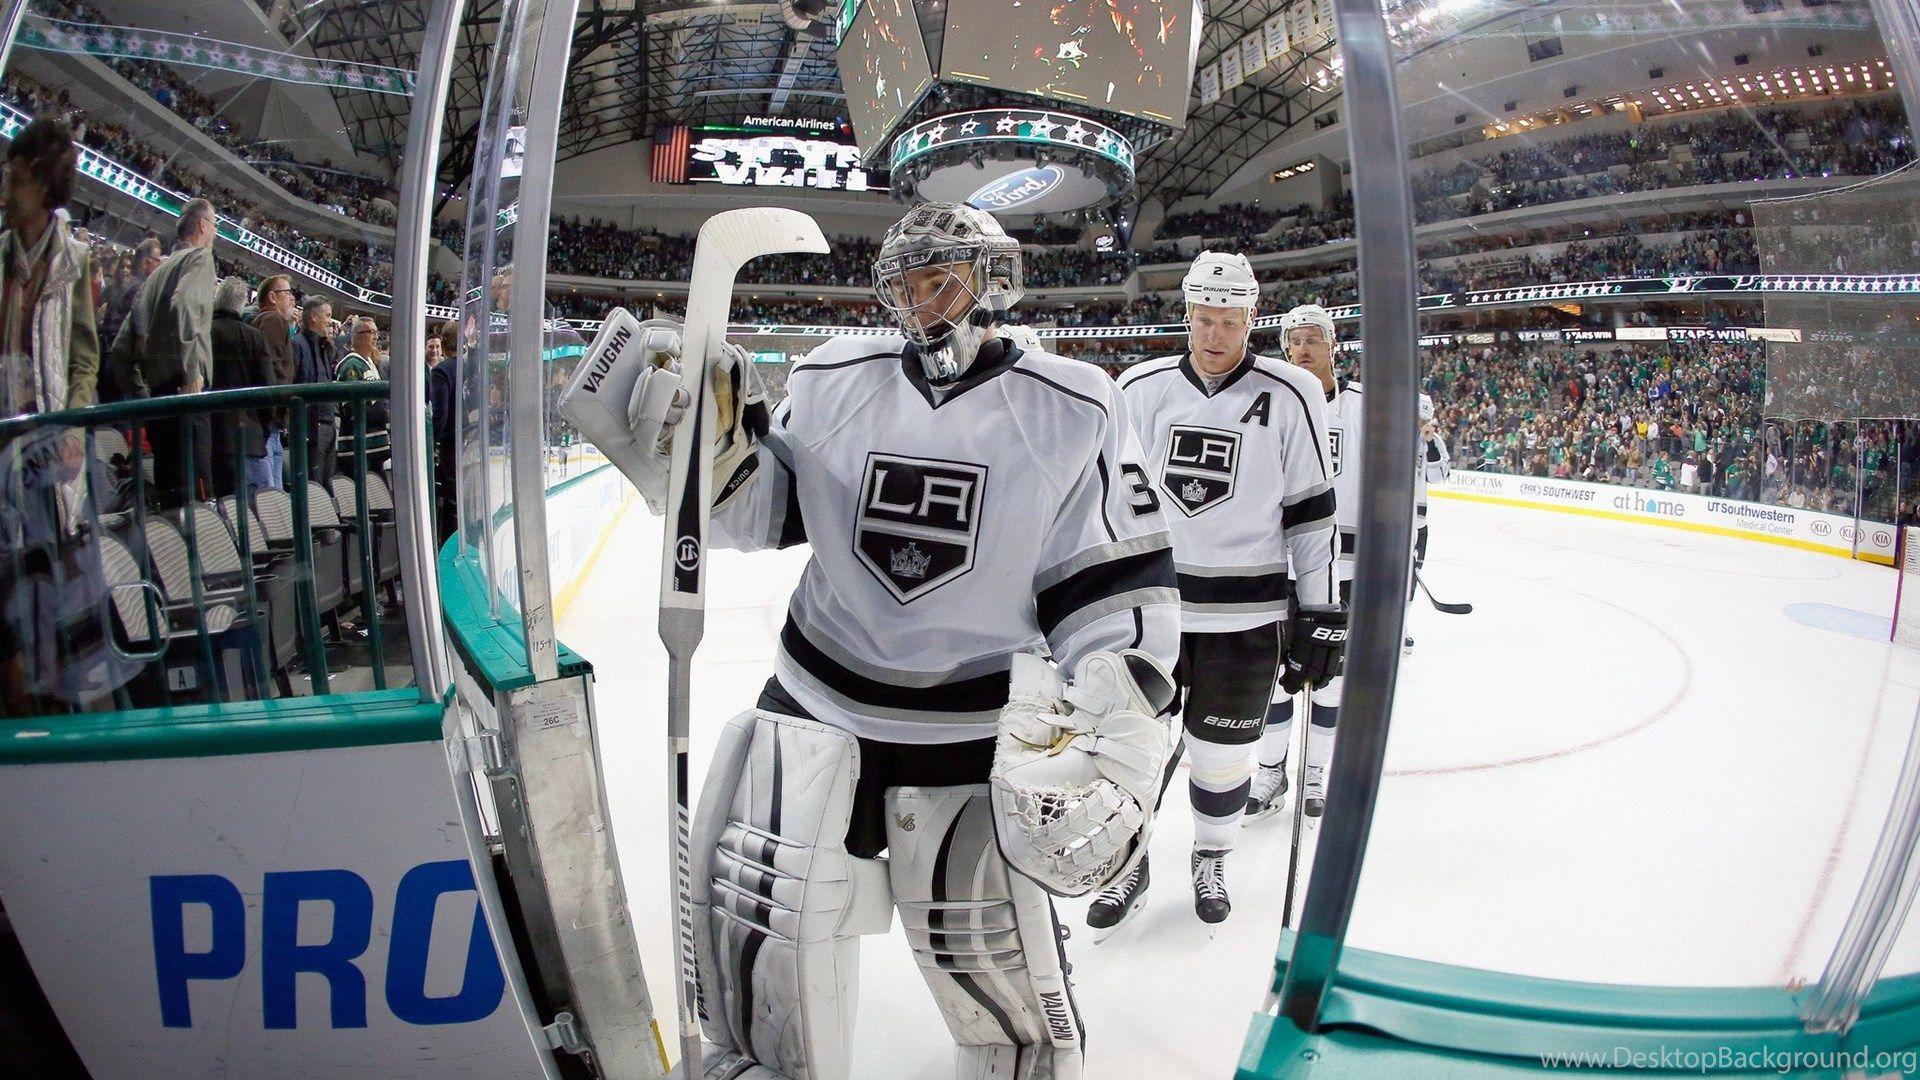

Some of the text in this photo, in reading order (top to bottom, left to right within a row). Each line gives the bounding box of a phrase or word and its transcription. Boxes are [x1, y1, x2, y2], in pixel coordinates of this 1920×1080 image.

[743, 115, 835, 131] American Airlines
[980, 176, 1048, 207] Ford
[1212, 266, 1224, 276] 2
[1716, 329, 1747, 341] WIN
[582, 325, 632, 395] VAUGHN
[1239, 391, 1271, 427] A
[1169, 434, 1233, 470] LA
[727, 468, 750, 491] QUICK
[1119, 461, 1161, 519] 3
[868, 469, 976, 523] LA
[1542, 486, 1597, 501] SOUTHWEST
[1613, 492, 1633, 511] at
[1721, 503, 1795, 524] Southwestern
[1736, 519, 1794, 536] Medical Center
[178, 669, 188, 689] A
[543, 715, 560, 727] 26C
[149, 858, 507, 1031] PRO
[1039, 990, 1074, 1042] VAUGHN
